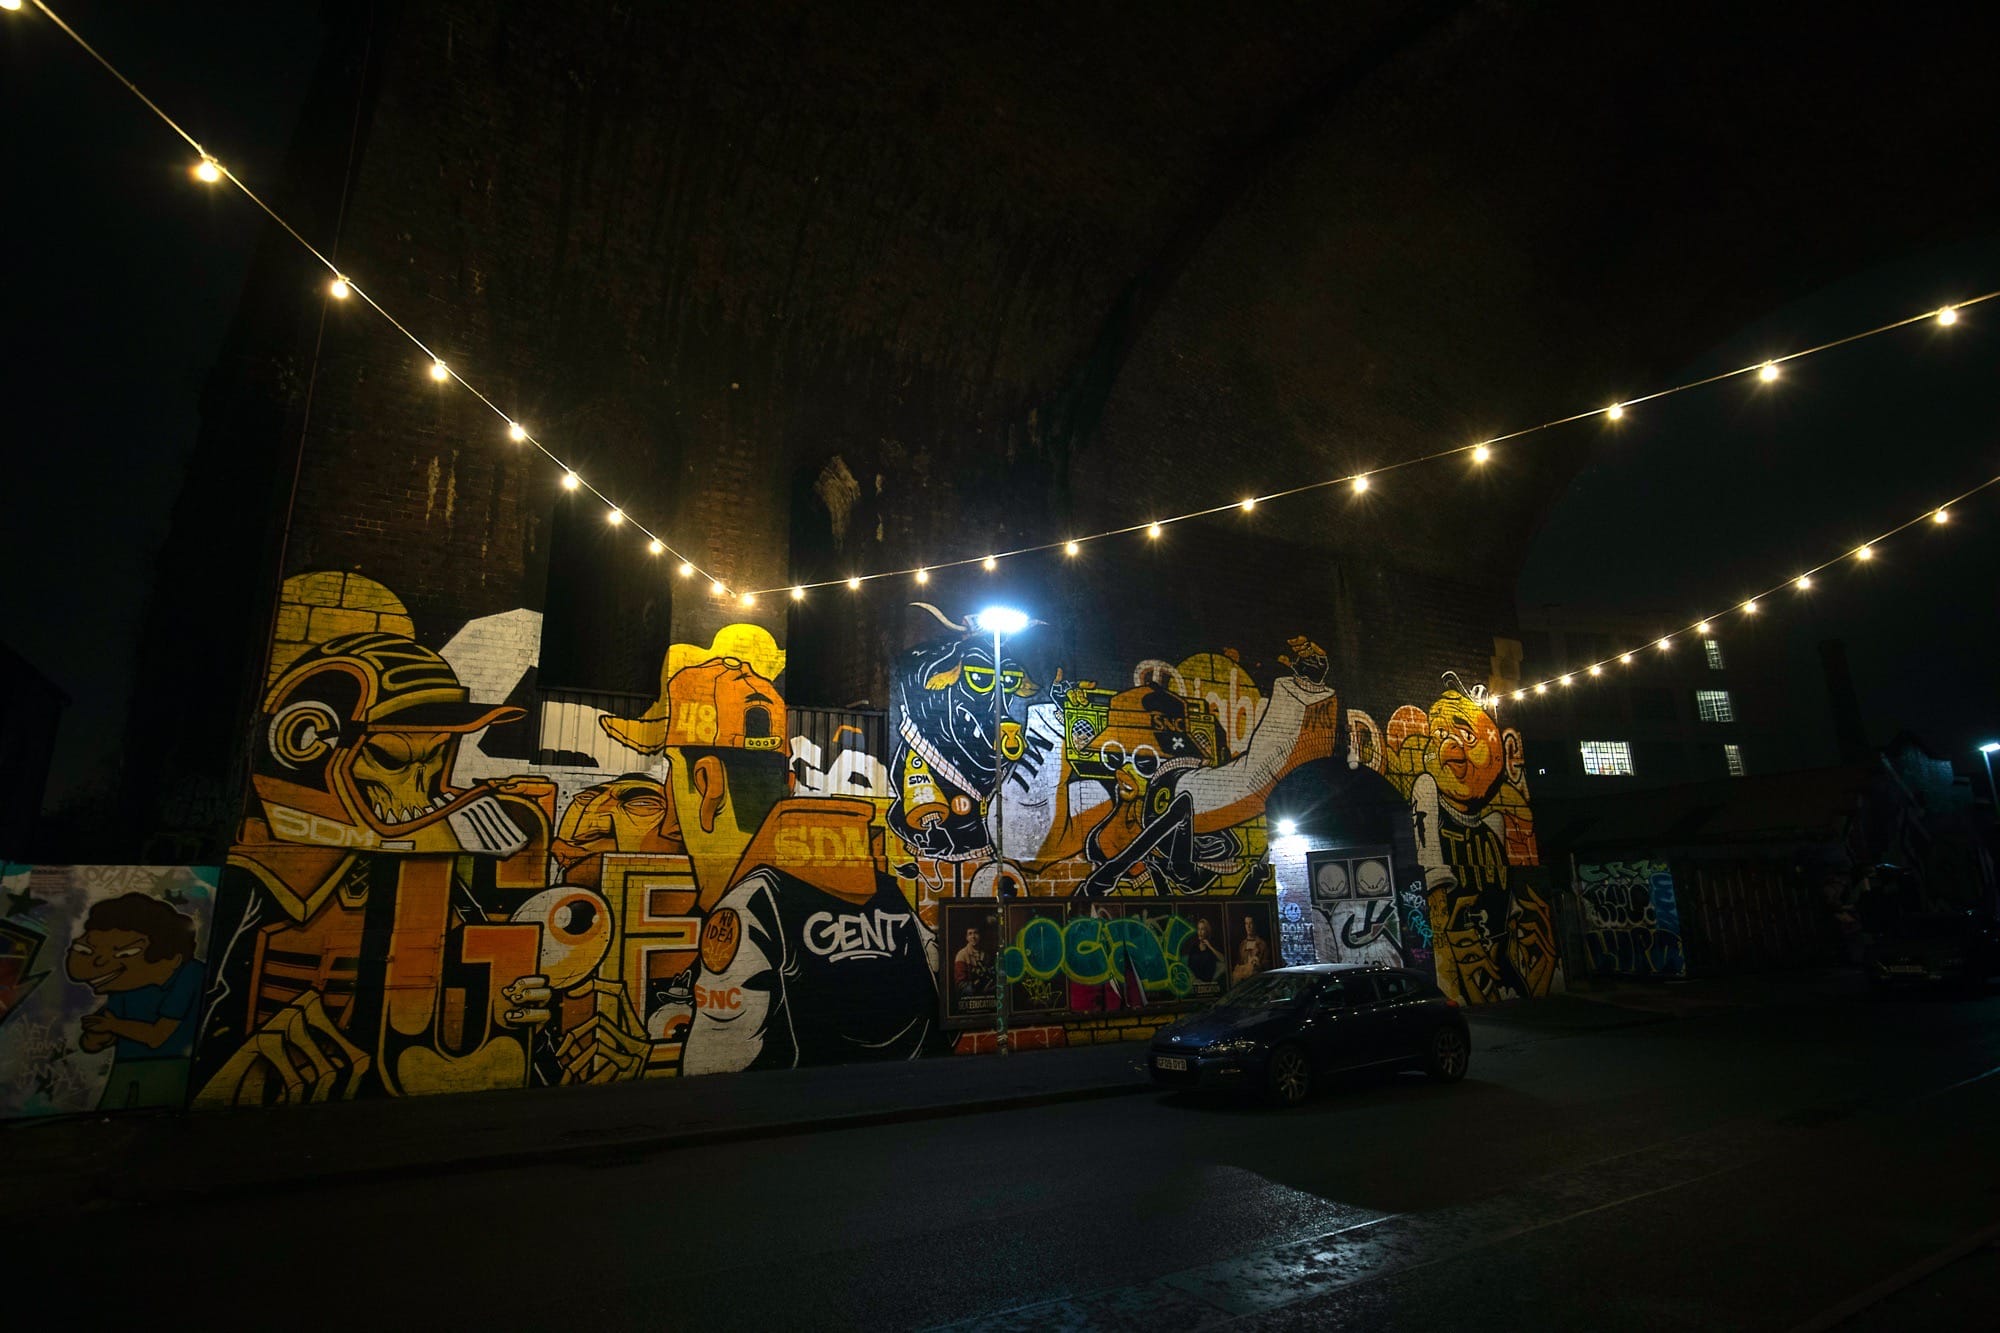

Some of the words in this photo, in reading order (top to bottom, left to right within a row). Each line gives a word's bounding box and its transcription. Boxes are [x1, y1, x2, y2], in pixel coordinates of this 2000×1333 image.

[676, 702, 716, 744] 48
[271, 808, 376, 848] SDM
[705, 925, 734, 943] IDEA
[803, 908, 911, 956] GENT
[694, 984, 743, 1010] SNC
